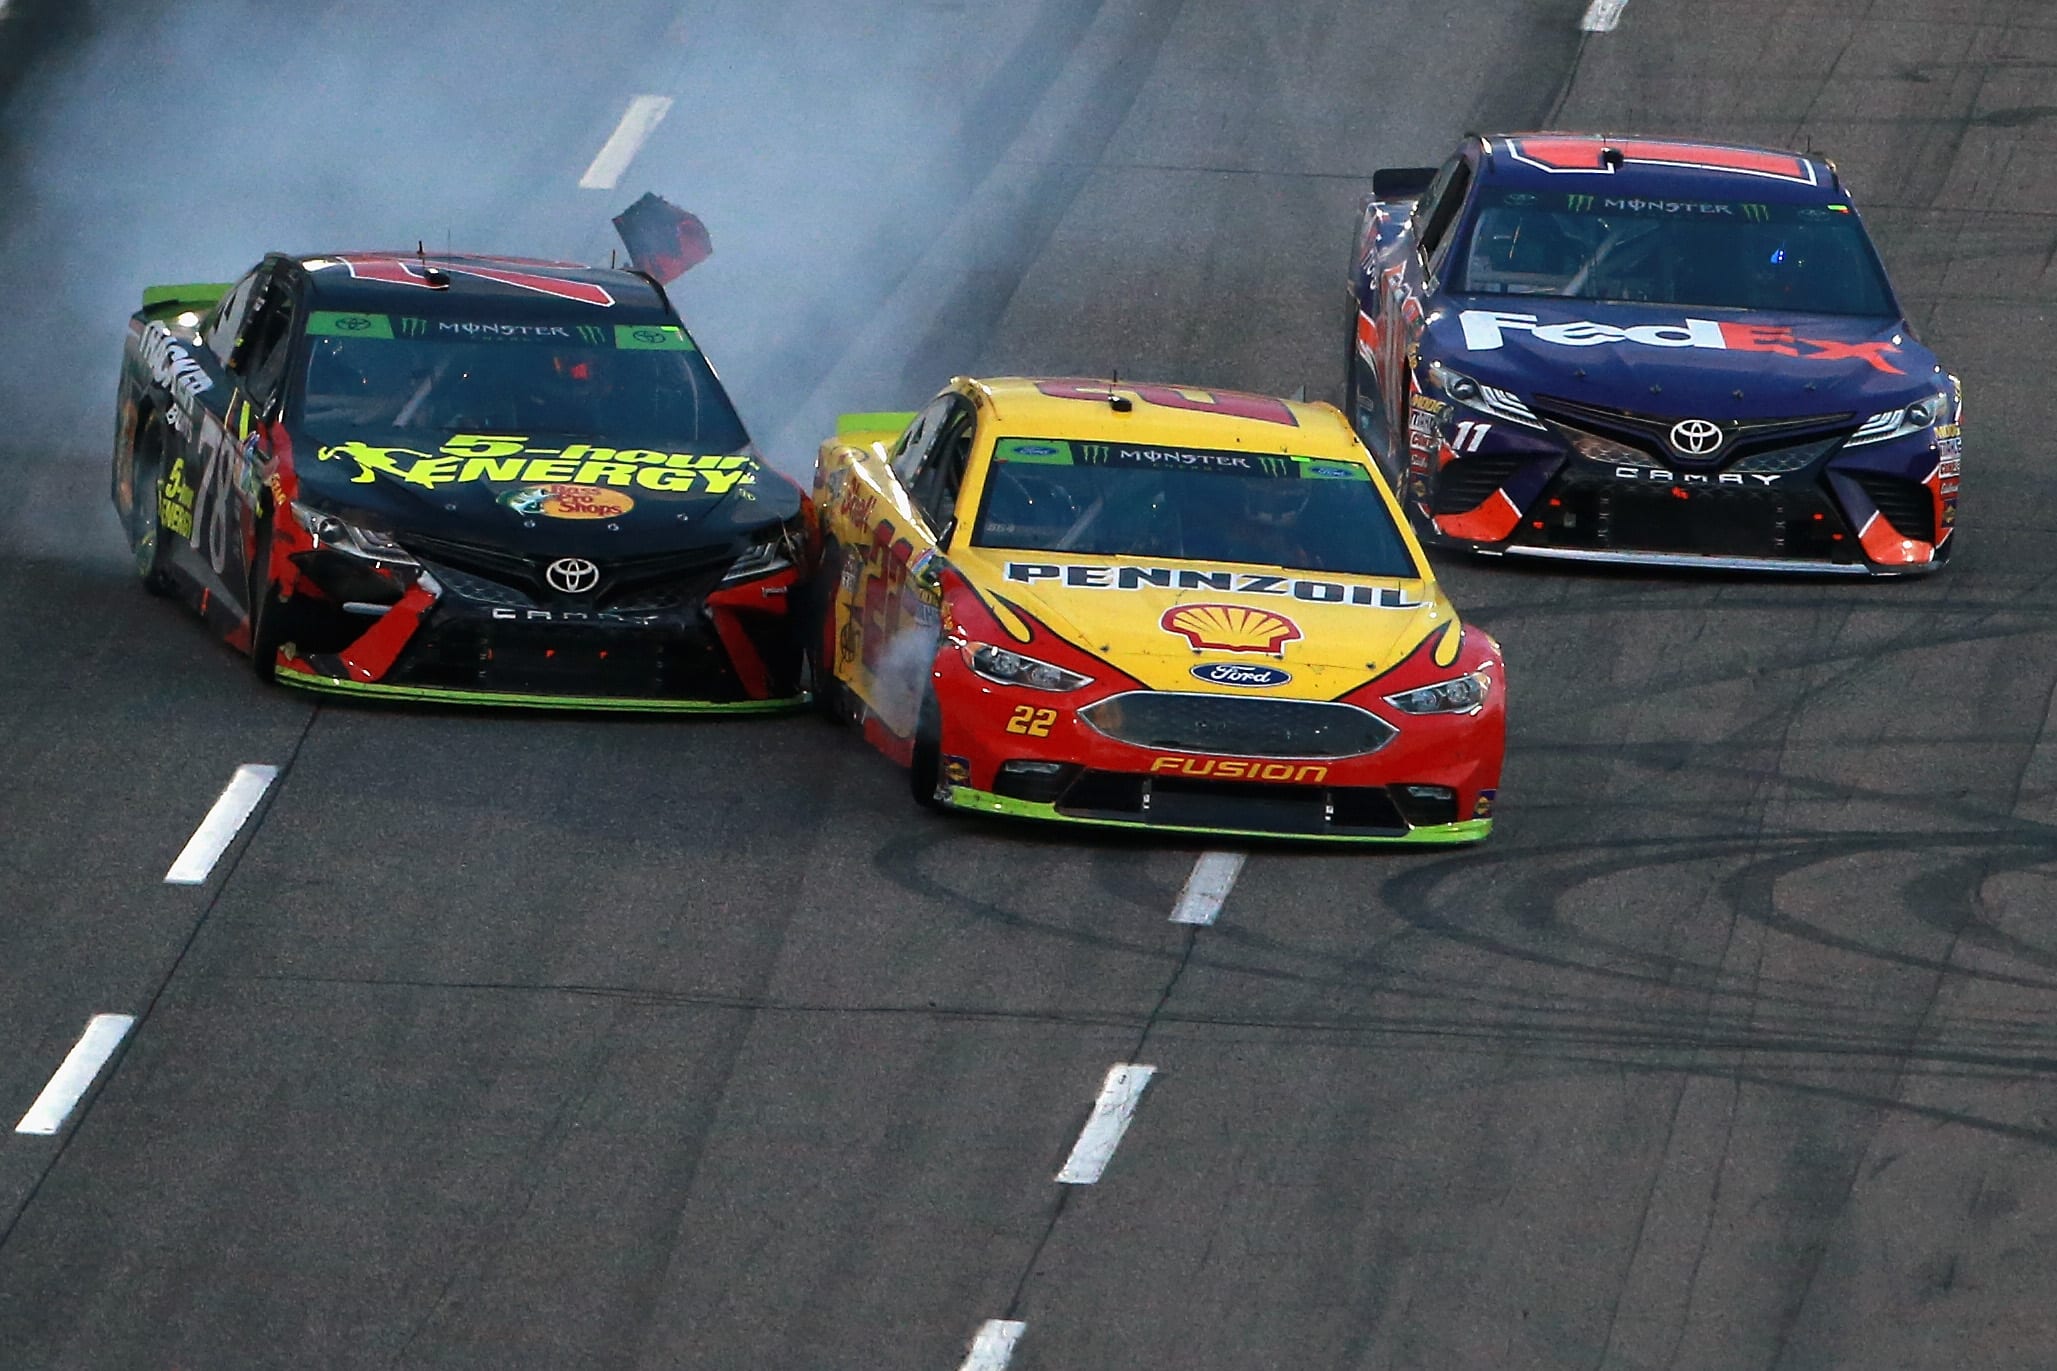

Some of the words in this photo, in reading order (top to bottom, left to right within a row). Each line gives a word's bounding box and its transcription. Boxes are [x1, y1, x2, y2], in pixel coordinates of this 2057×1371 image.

[1604, 198, 1733, 215] MONSTER
[439, 322, 570, 337] MONSTER
[1458, 309, 1907, 375] FedEx
[1451, 420, 1492, 452] 11
[440, 434, 760, 470] 5-hour
[1120, 448, 1251, 469] MONSTER
[408, 456, 757, 493] ENERGY
[1615, 466, 1782, 486] CAMRY
[558, 502, 623, 516] Shops
[1005, 562, 1430, 608] PENNZOIL
[1210, 664, 1272, 683] Ford
[1005, 704, 1058, 738] 22
[1150, 756, 1329, 783] FUSION
